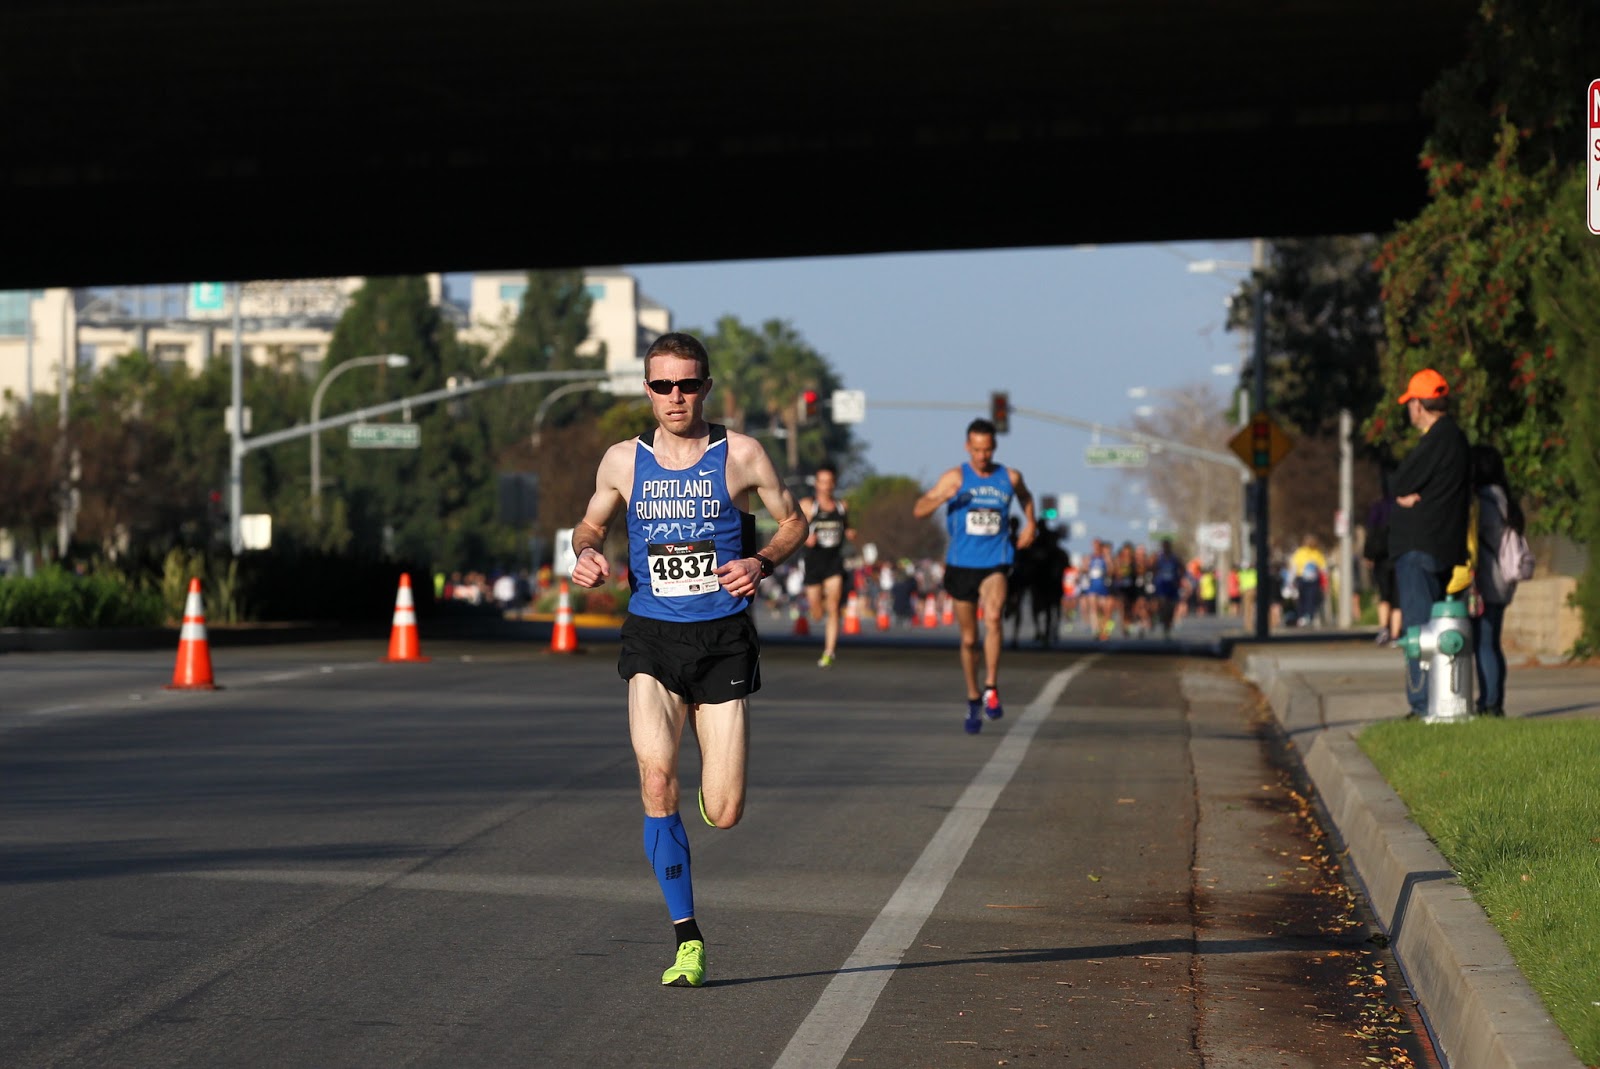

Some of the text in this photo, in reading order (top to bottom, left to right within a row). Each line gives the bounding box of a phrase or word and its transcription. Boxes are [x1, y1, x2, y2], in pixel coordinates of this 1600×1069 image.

[643, 480, 712, 499] PORTLAND
[636, 500, 720, 519] RUNNING CO
[653, 554, 714, 580] 4837
